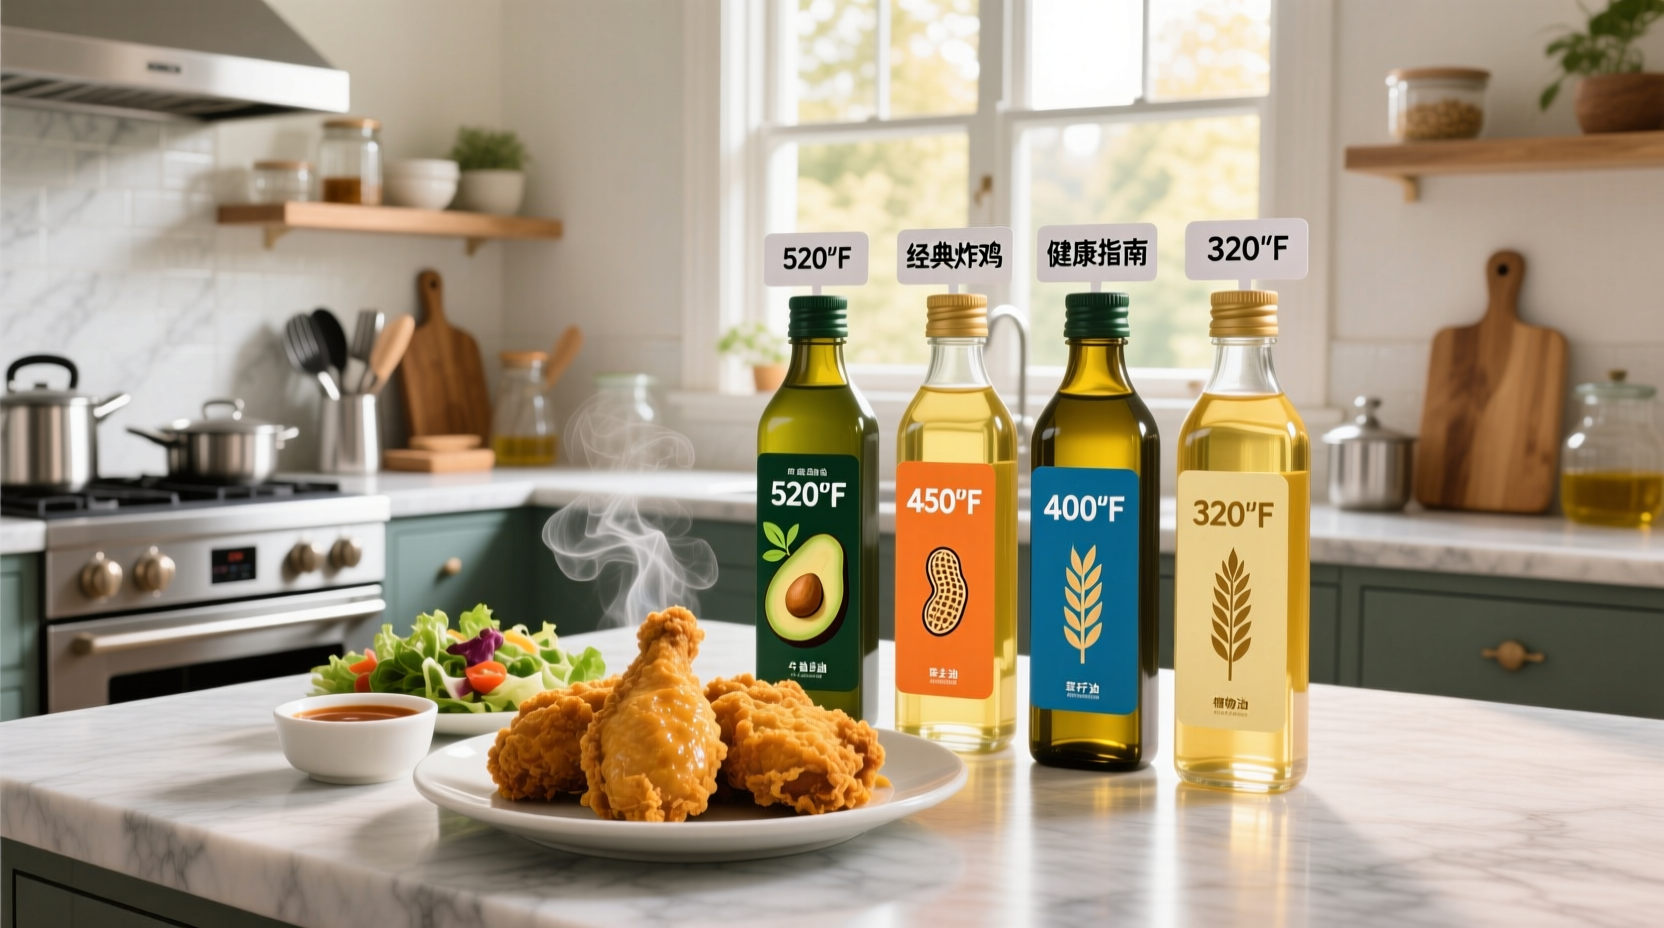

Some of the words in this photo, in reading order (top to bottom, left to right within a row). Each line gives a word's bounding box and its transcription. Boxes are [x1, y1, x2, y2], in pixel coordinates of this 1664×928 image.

[906, 241, 1003, 270] 经典炸鸡
[1046, 238, 1149, 268] 健康指南
